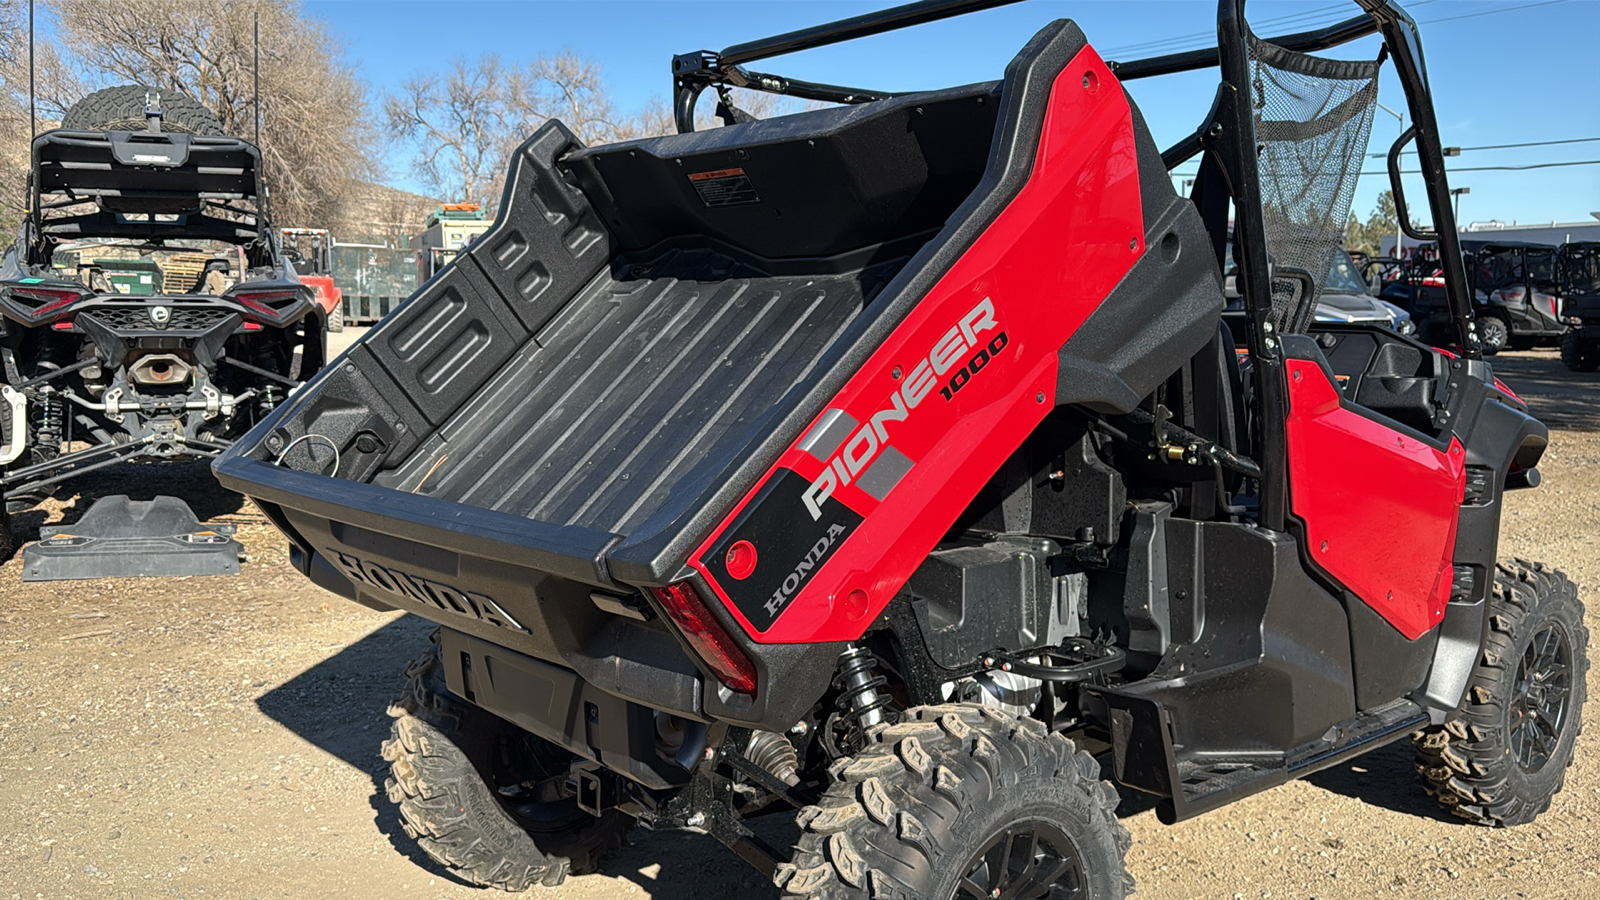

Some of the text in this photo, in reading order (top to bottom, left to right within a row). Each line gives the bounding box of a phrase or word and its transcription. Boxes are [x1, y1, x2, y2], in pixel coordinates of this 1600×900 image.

[801, 296, 998, 521] PIONEER
[939, 331, 1008, 402] 1000
[326, 547, 532, 635] HONDA
[763, 523, 846, 617] HONDA
